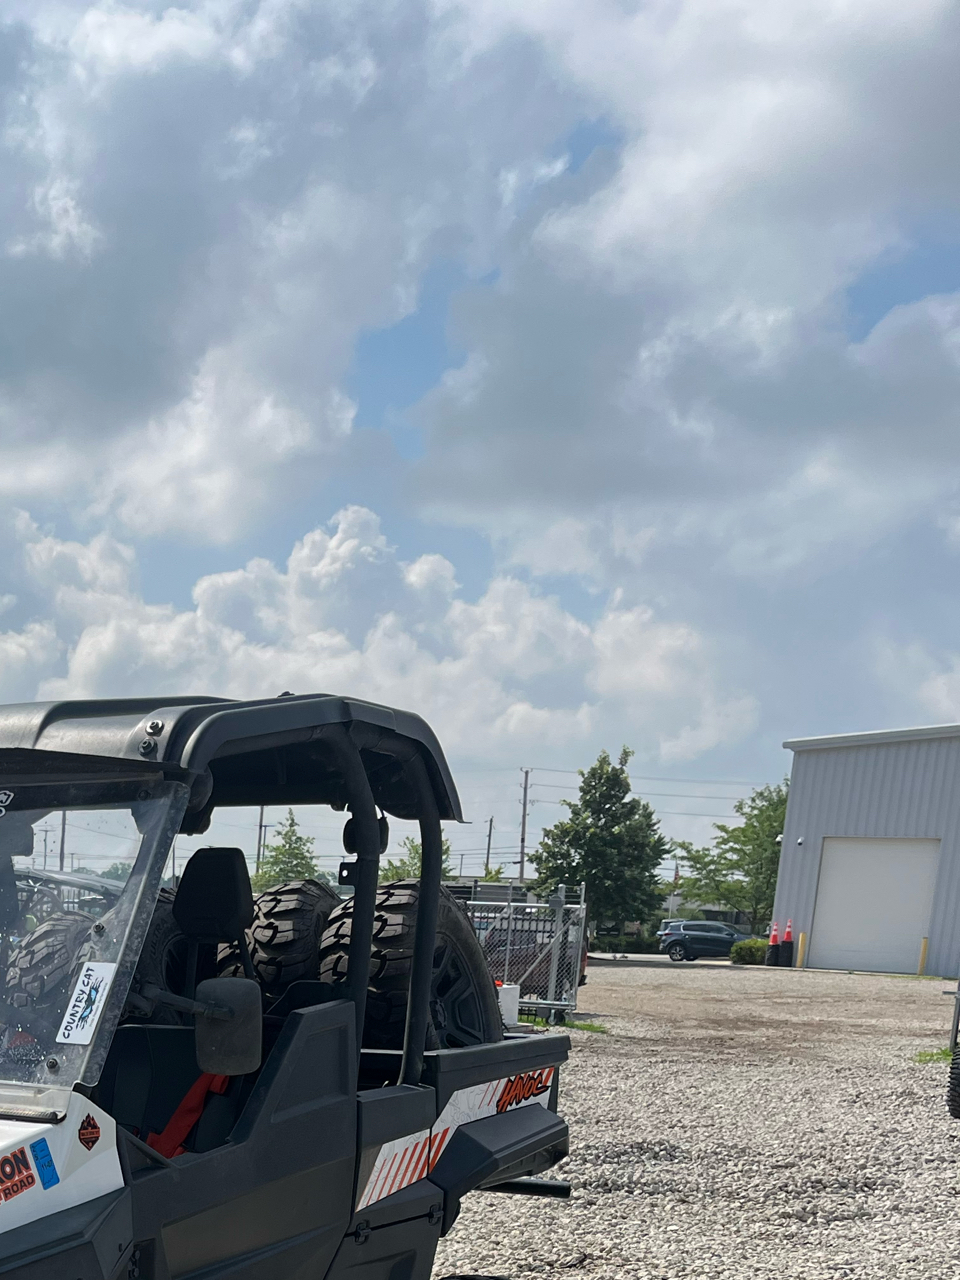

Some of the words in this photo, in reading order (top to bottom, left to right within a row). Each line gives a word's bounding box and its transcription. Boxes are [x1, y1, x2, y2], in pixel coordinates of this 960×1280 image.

[62, 989, 87, 1039] COUNTRY
[82, 966, 95, 987] CAT
[496, 1071, 551, 1114] HAVOC
[4, 1175, 35, 1200] ROAD
